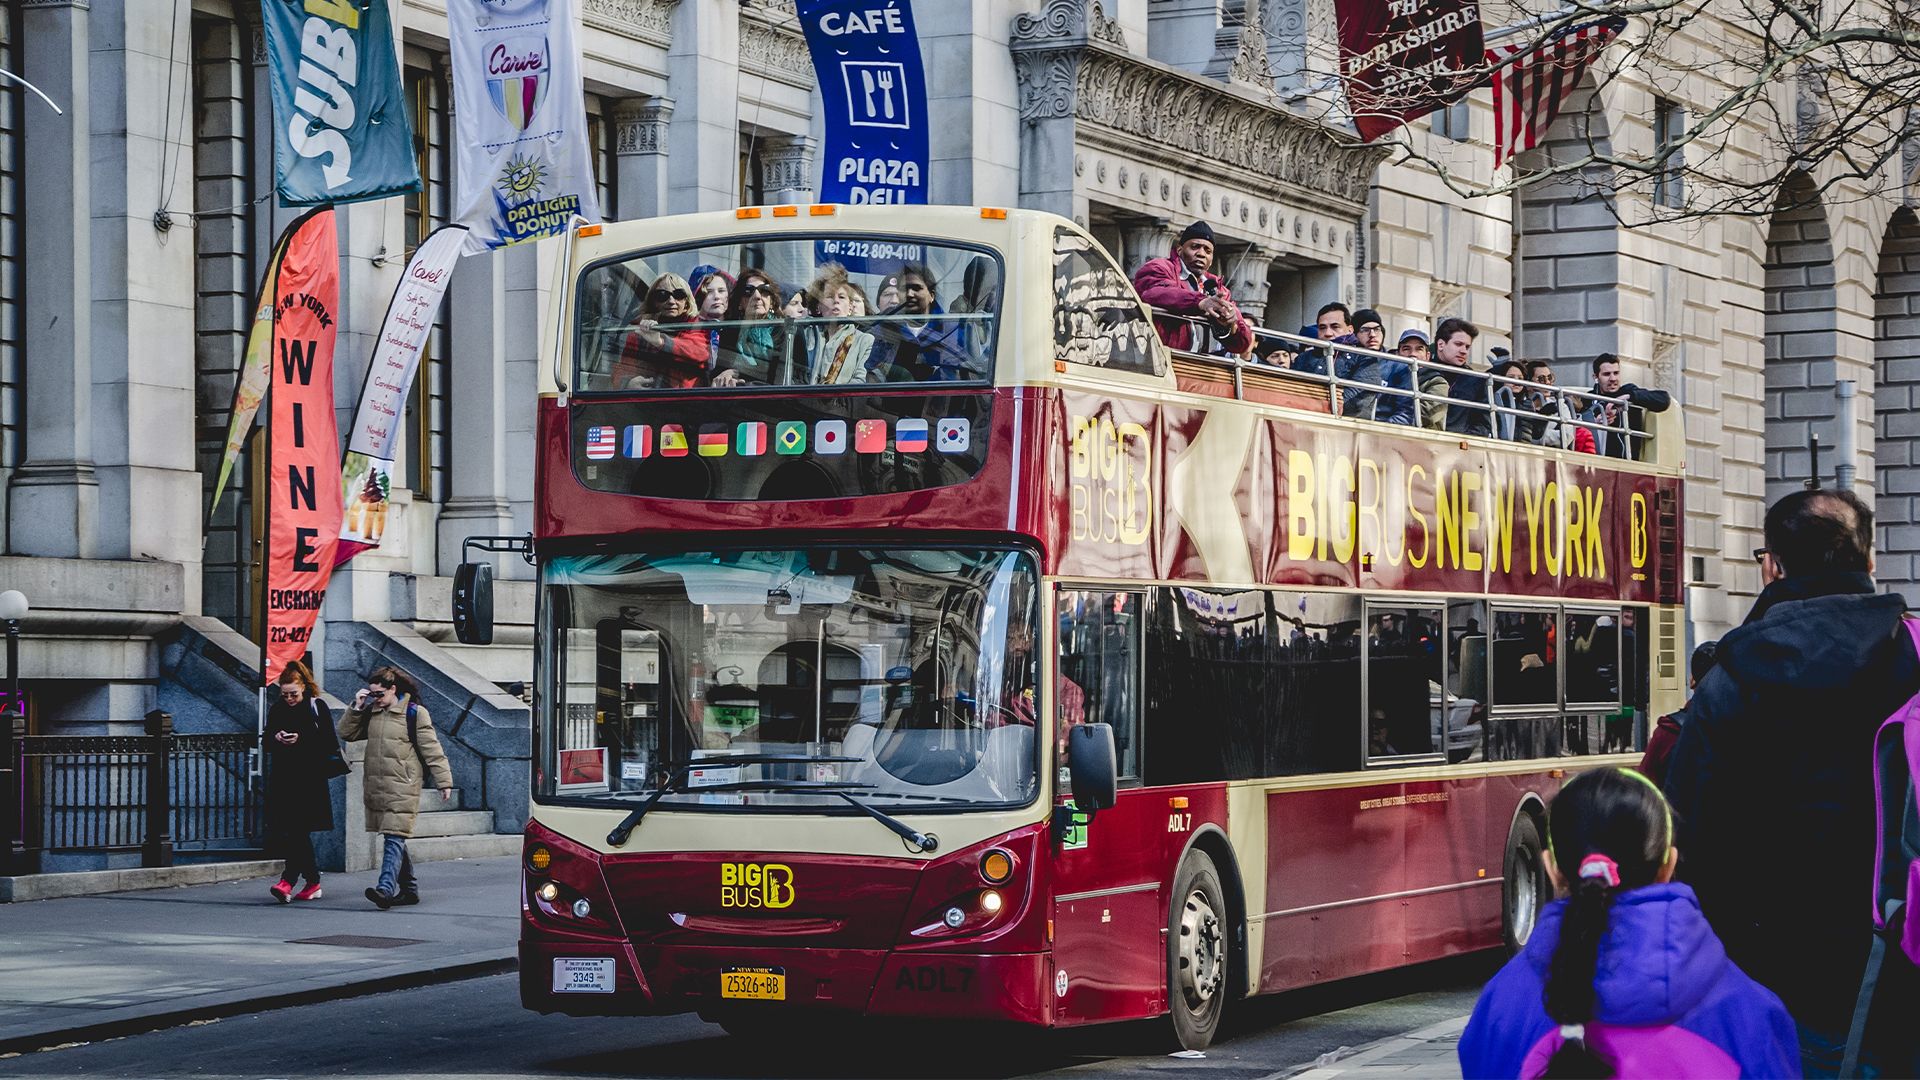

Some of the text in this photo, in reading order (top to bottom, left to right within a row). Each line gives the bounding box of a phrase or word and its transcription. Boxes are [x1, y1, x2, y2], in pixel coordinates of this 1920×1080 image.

[819, 1, 905, 36] CAFÉ
[1348, 5, 1479, 77] BERKSHIRE
[1381, 56, 1451, 94] BANK
[838, 157, 920, 187] PLAZA
[507, 195, 577, 223] DAYLIGHT
[847, 241, 920, 261] 212-809-4101
[276, 293, 333, 330] NEW YORK
[280, 337, 319, 573] WINE
[1073, 415, 1117, 482] BIG
[1073, 484, 1117, 544] BUS
[1288, 449, 1356, 564] BIG
[1436, 465, 1514, 573] NEW
[1523, 480, 1605, 579] YORK
[722, 863, 761, 886] BIG
[722, 887, 761, 908] BUS
[573, 972, 594, 983] 3349
